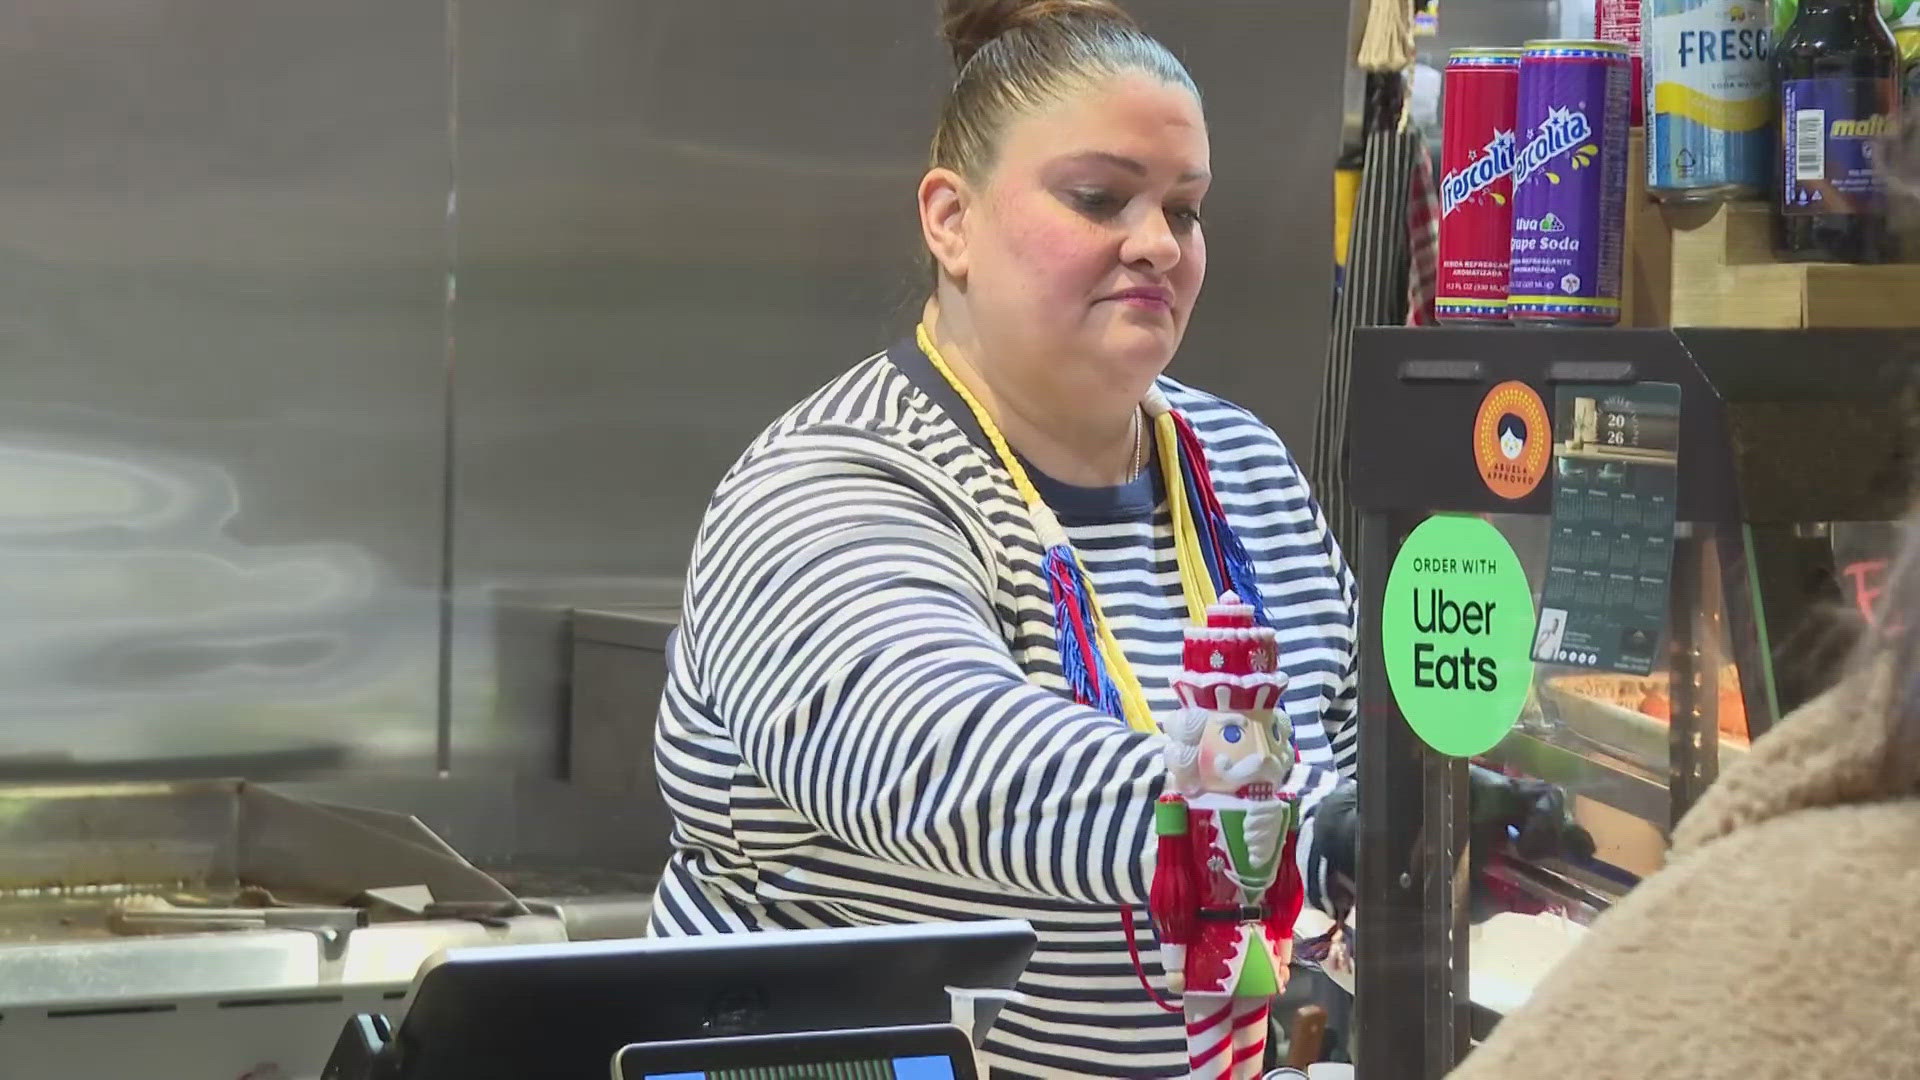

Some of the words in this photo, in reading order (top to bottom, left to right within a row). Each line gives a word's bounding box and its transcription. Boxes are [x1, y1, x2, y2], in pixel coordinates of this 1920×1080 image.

[1679, 28, 1768, 68] FRESC
[1831, 113, 1889, 138] malt
[1514, 112, 1592, 184] escolita
[1441, 130, 1515, 218] Frescolit
[1511, 238, 1536, 252] rape
[1540, 236, 1580, 251] Soda
[1464, 260, 1509, 270] REFRESCAN
[1607, 414, 1626, 429] 20
[1607, 430, 1625, 445] 26
[1493, 462, 1528, 474] ABUELA
[1487, 471, 1534, 486] APPROVED
[1413, 557, 1457, 573] ORDER
[1462, 559, 1497, 574] WITH
[1413, 587, 1497, 636] Uber
[1414, 643, 1498, 692] Eats
